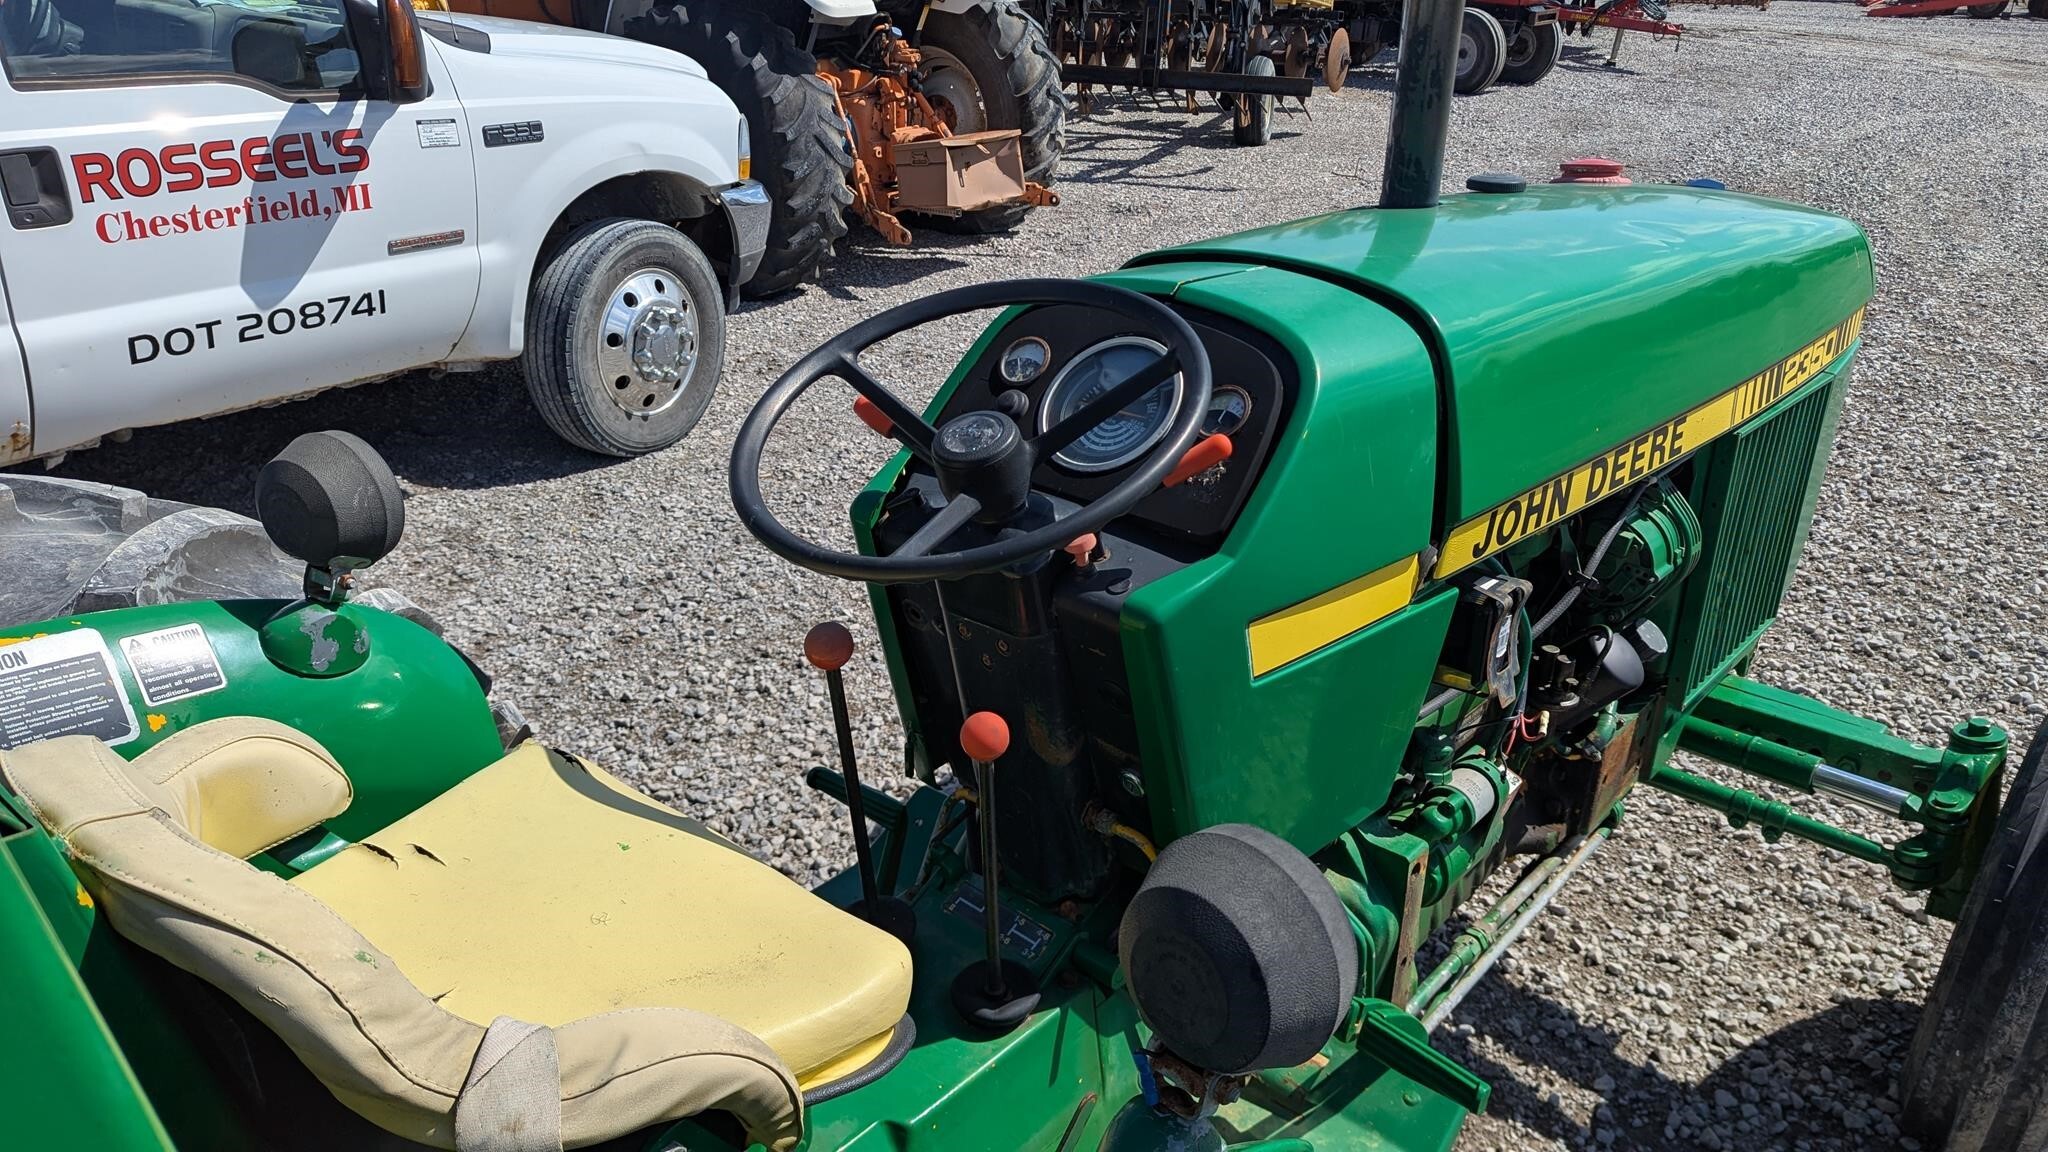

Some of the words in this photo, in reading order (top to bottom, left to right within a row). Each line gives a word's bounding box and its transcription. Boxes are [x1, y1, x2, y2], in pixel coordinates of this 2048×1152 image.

[70, 128, 370, 204] ROSSEEL'S
[128, 319, 222, 365] DOT
[236, 289, 387, 343] 208741
[1781, 328, 1838, 394] 2350
[1472, 471, 1574, 559] JOHN
[1584, 415, 1687, 504] DEERE
[152, 628, 200, 645] CAUTION
[144, 665, 195, 684] recommended
[149, 683, 173, 693] almost
[184, 671, 218, 684] operating
[152, 687, 192, 701] conditions.
